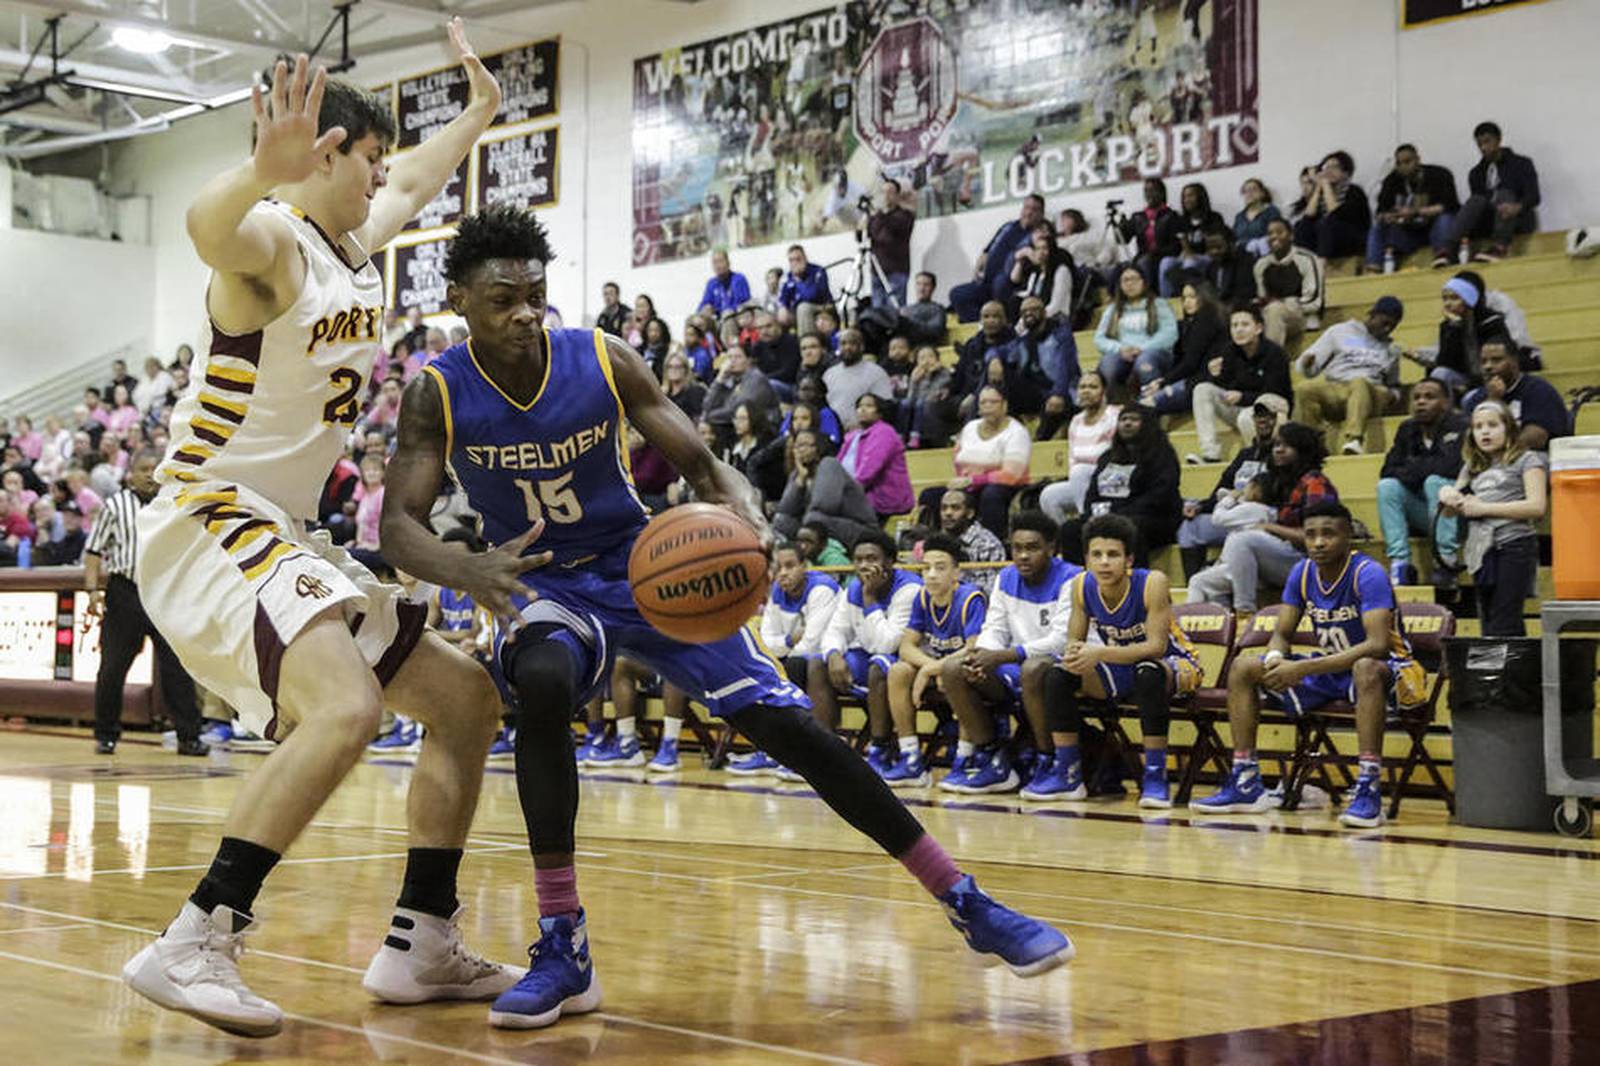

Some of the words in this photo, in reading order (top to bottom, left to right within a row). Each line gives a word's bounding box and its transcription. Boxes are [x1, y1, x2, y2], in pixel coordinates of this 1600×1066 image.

[643, 26, 796, 93] WELCOME
[809, 13, 848, 51] TO
[982, 114, 1241, 204] LOCKPORT
[465, 420, 609, 470] STEELMEN
[513, 470, 583, 524] 15
[656, 563, 750, 601] Wilson
